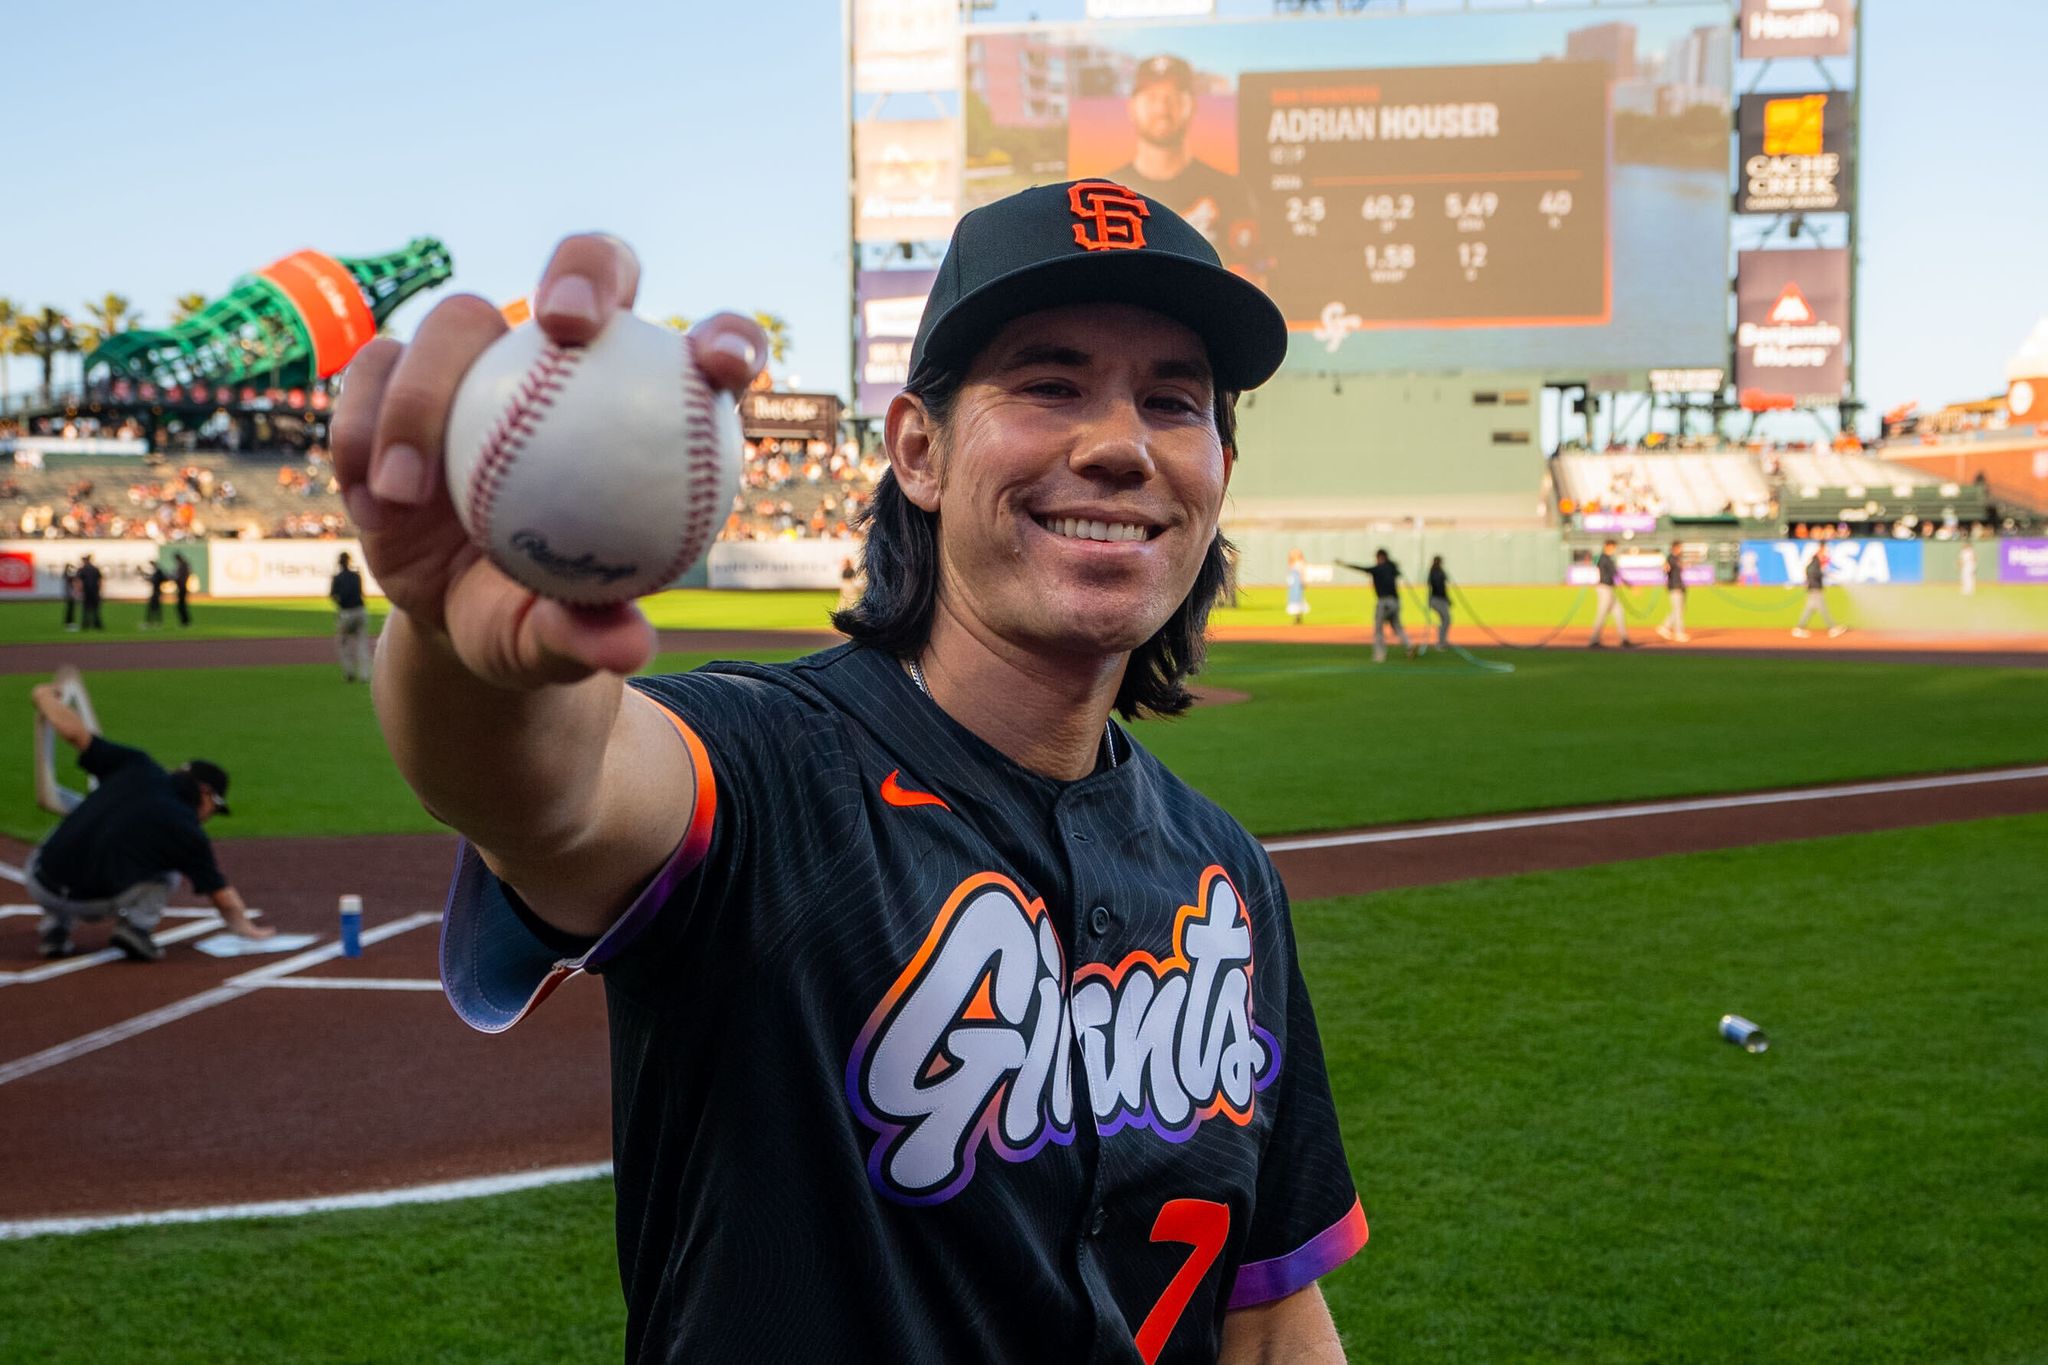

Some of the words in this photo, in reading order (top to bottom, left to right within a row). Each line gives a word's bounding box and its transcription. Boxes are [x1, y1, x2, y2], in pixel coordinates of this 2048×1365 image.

[1267, 107, 1376, 143] ADRIAN
[1380, 103, 1499, 141] HOUSER
[1458, 241, 1488, 268] 12
[850, 866, 1280, 1202] Giants
[1134, 1198, 1230, 1365] 7
